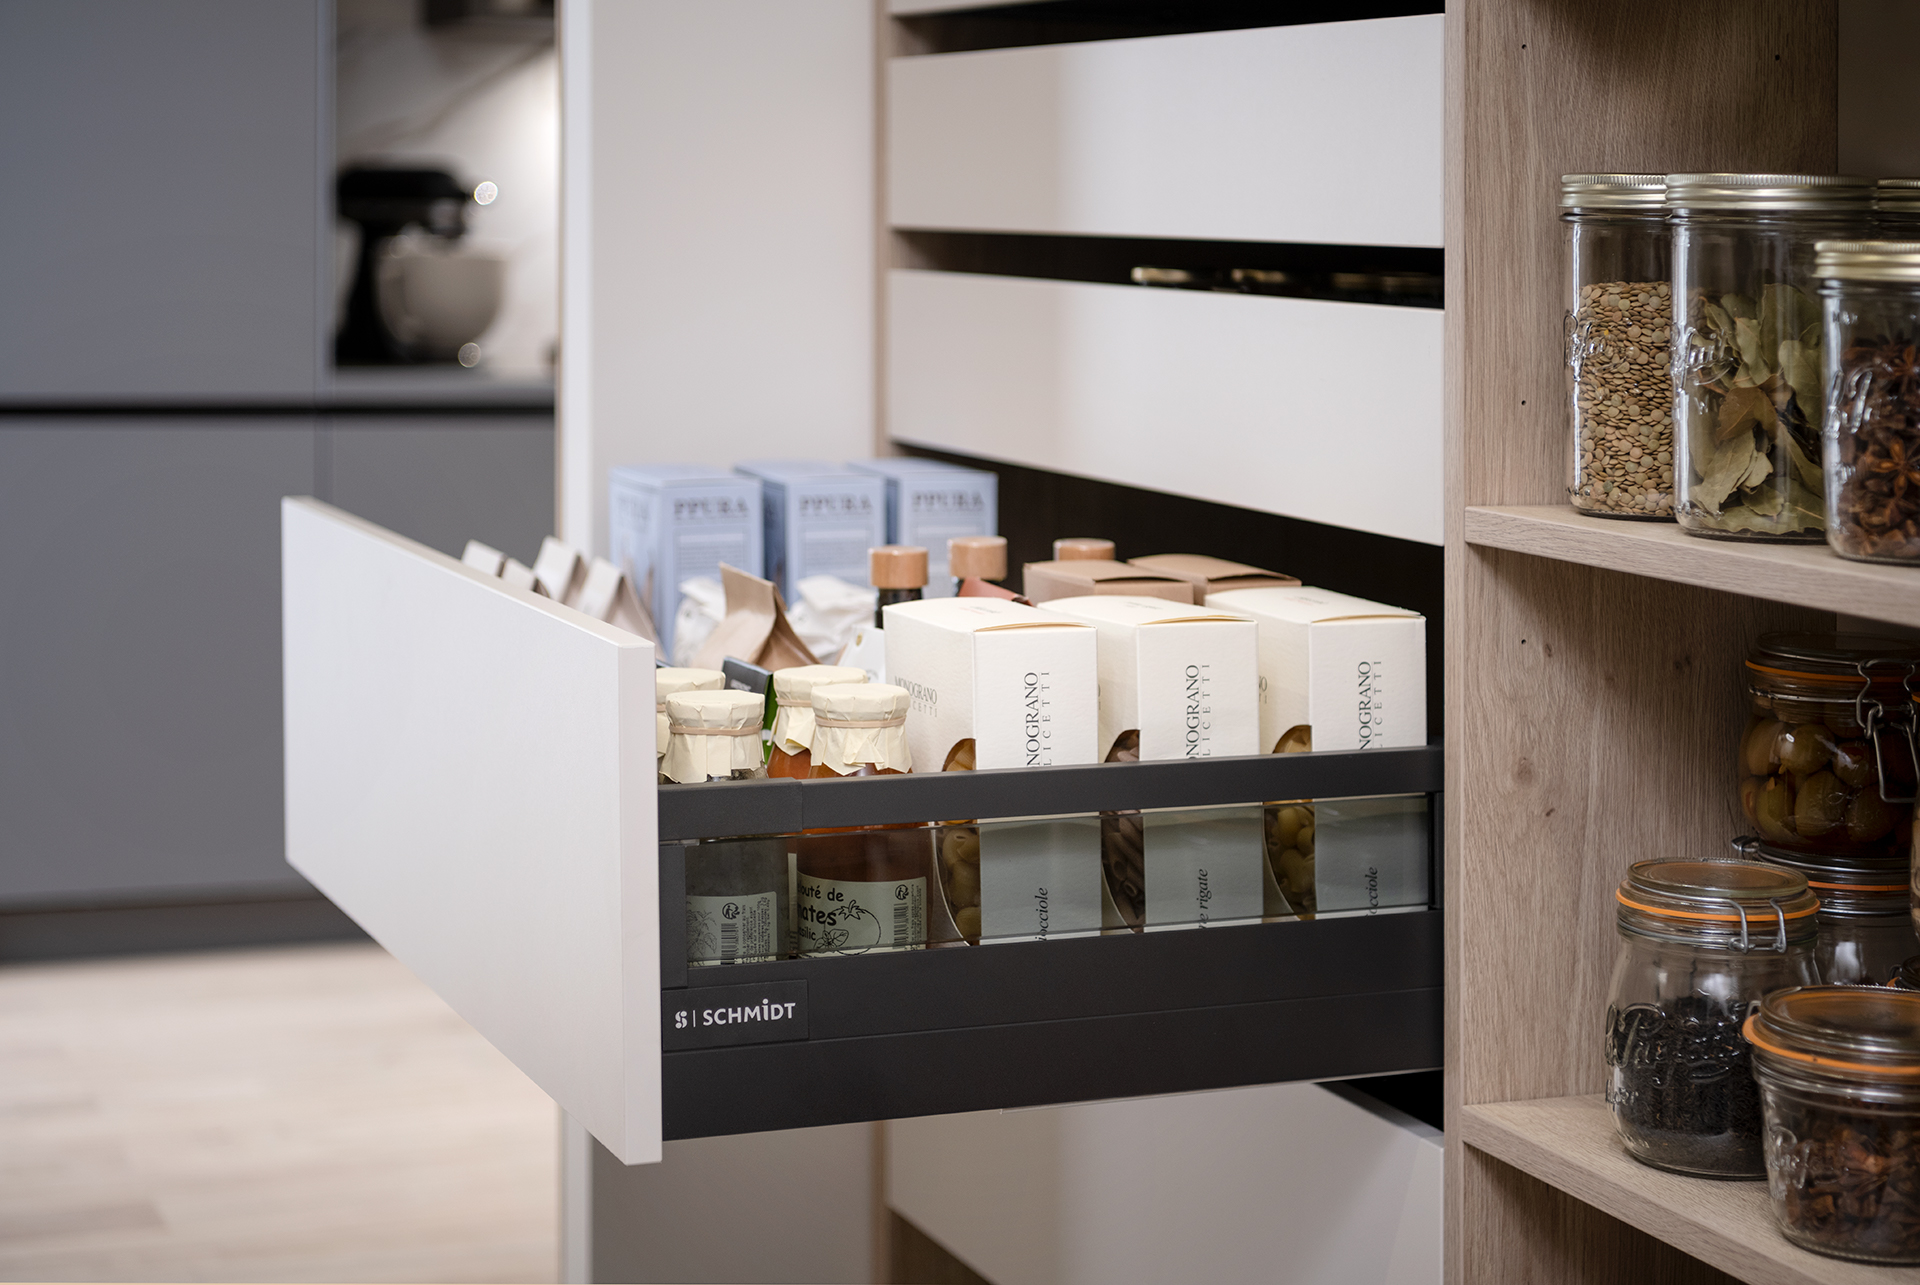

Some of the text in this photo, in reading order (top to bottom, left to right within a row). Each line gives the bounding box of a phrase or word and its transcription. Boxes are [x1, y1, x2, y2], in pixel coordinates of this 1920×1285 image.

[1185, 664, 1200, 759] NOGRANO
[1373, 661, 1383, 748] ICETTI
[798, 884, 844, 902] outé de
[1196, 868, 1212, 909] rigate
[1365, 866, 1379, 914] occiole
